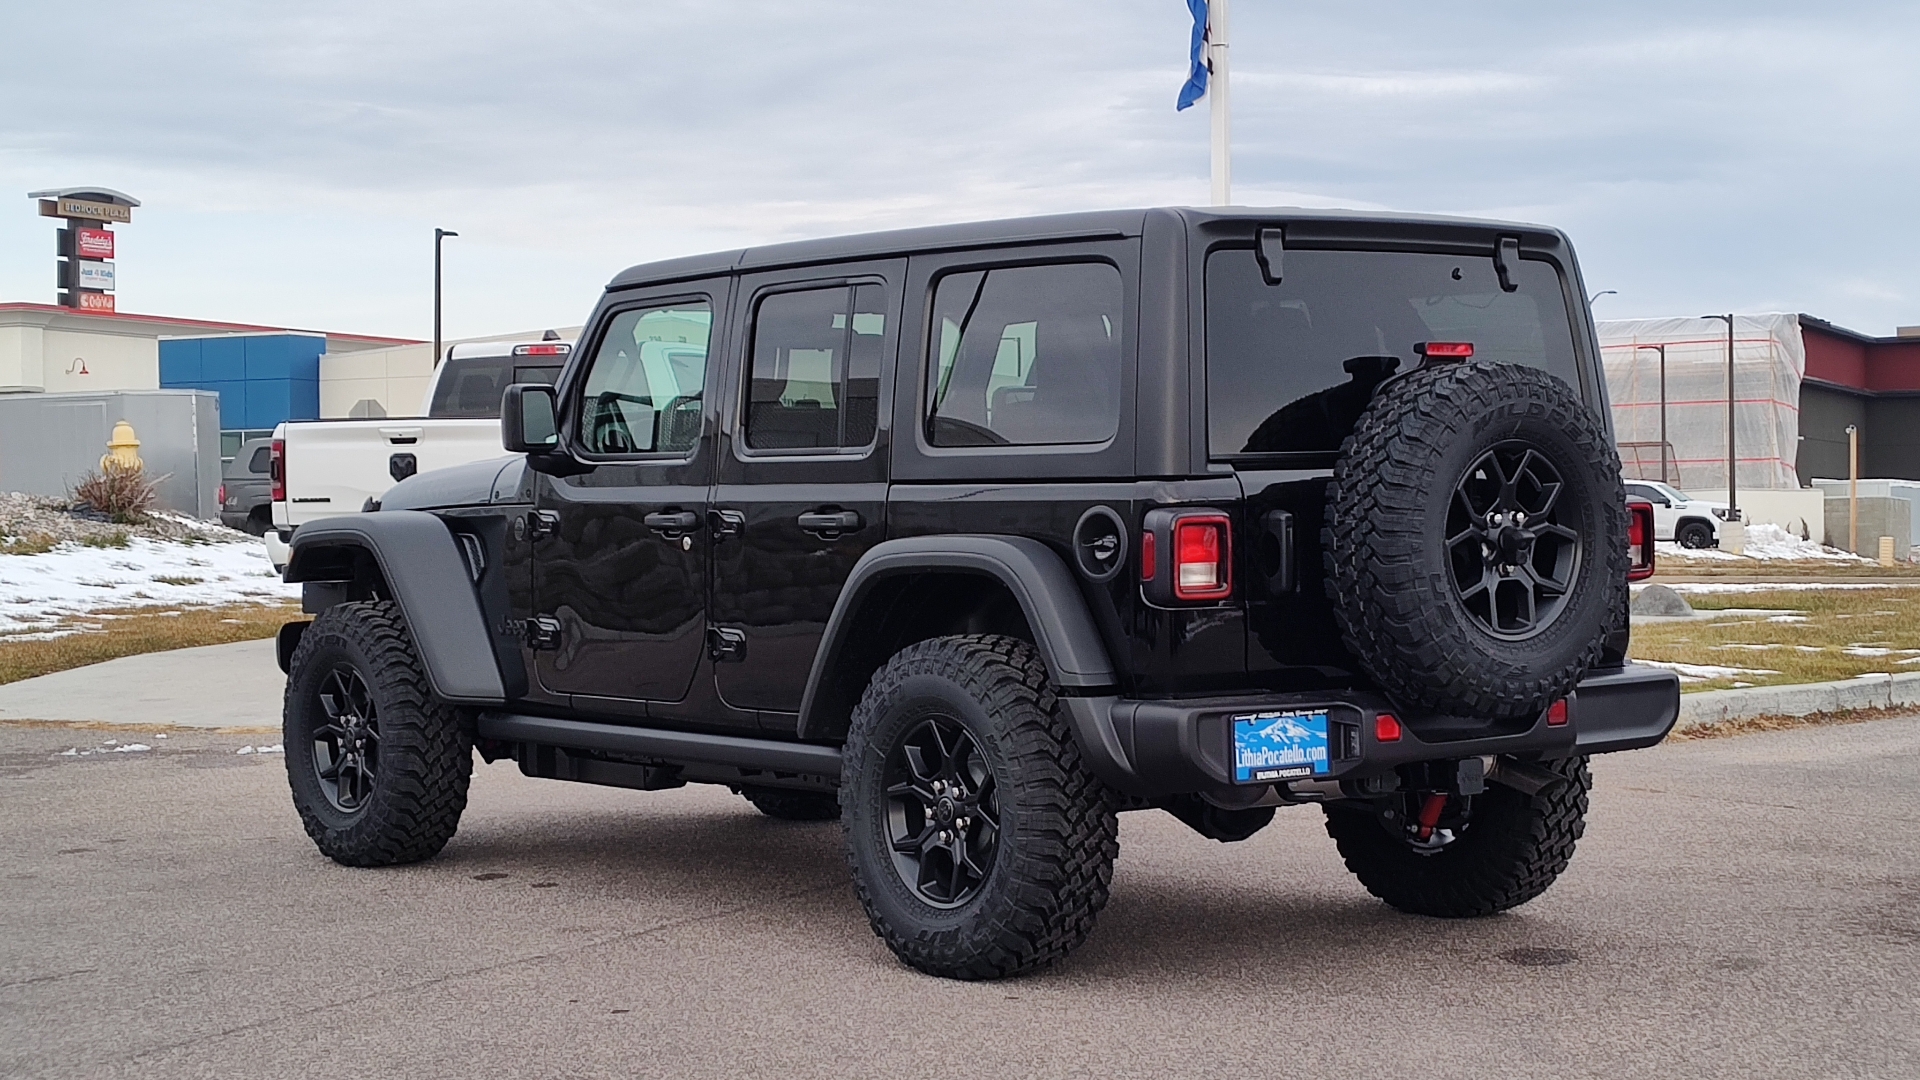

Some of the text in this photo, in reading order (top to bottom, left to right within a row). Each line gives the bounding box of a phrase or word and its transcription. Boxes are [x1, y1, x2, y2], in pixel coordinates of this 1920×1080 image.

[64, 202, 130, 218] BEDROCK PLAZA
[1235, 743, 1327, 768] LithiaPocatello.com
